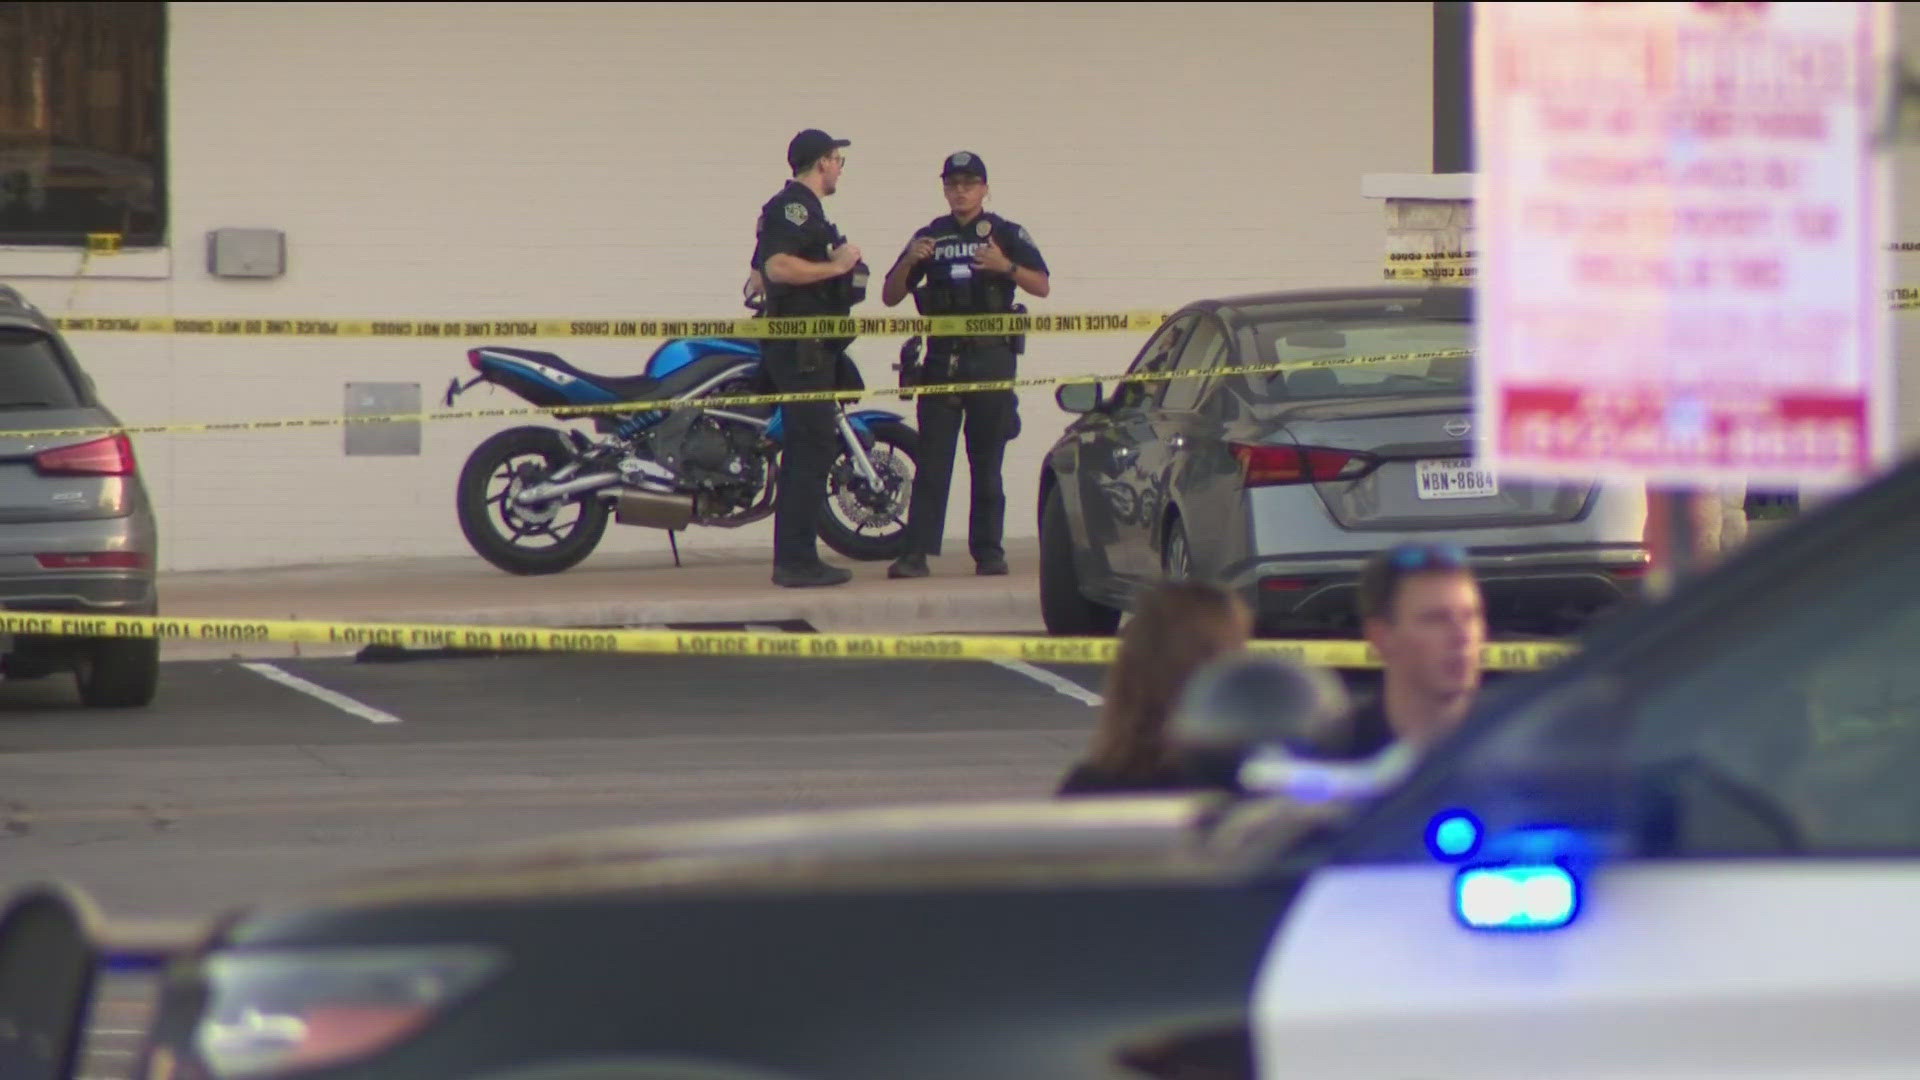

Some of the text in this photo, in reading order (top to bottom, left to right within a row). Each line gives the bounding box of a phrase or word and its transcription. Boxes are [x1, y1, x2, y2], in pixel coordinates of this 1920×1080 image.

[371, 321, 538, 336] POLICE LINE DO NOT CROSS
[569, 320, 735, 336] POLICE LINE DO NOT CROSS
[768, 318, 932, 335] POLICE LINE DO NOT CROSS
[965, 314, 1128, 332] POLICE LINE DO NOT CROSS
